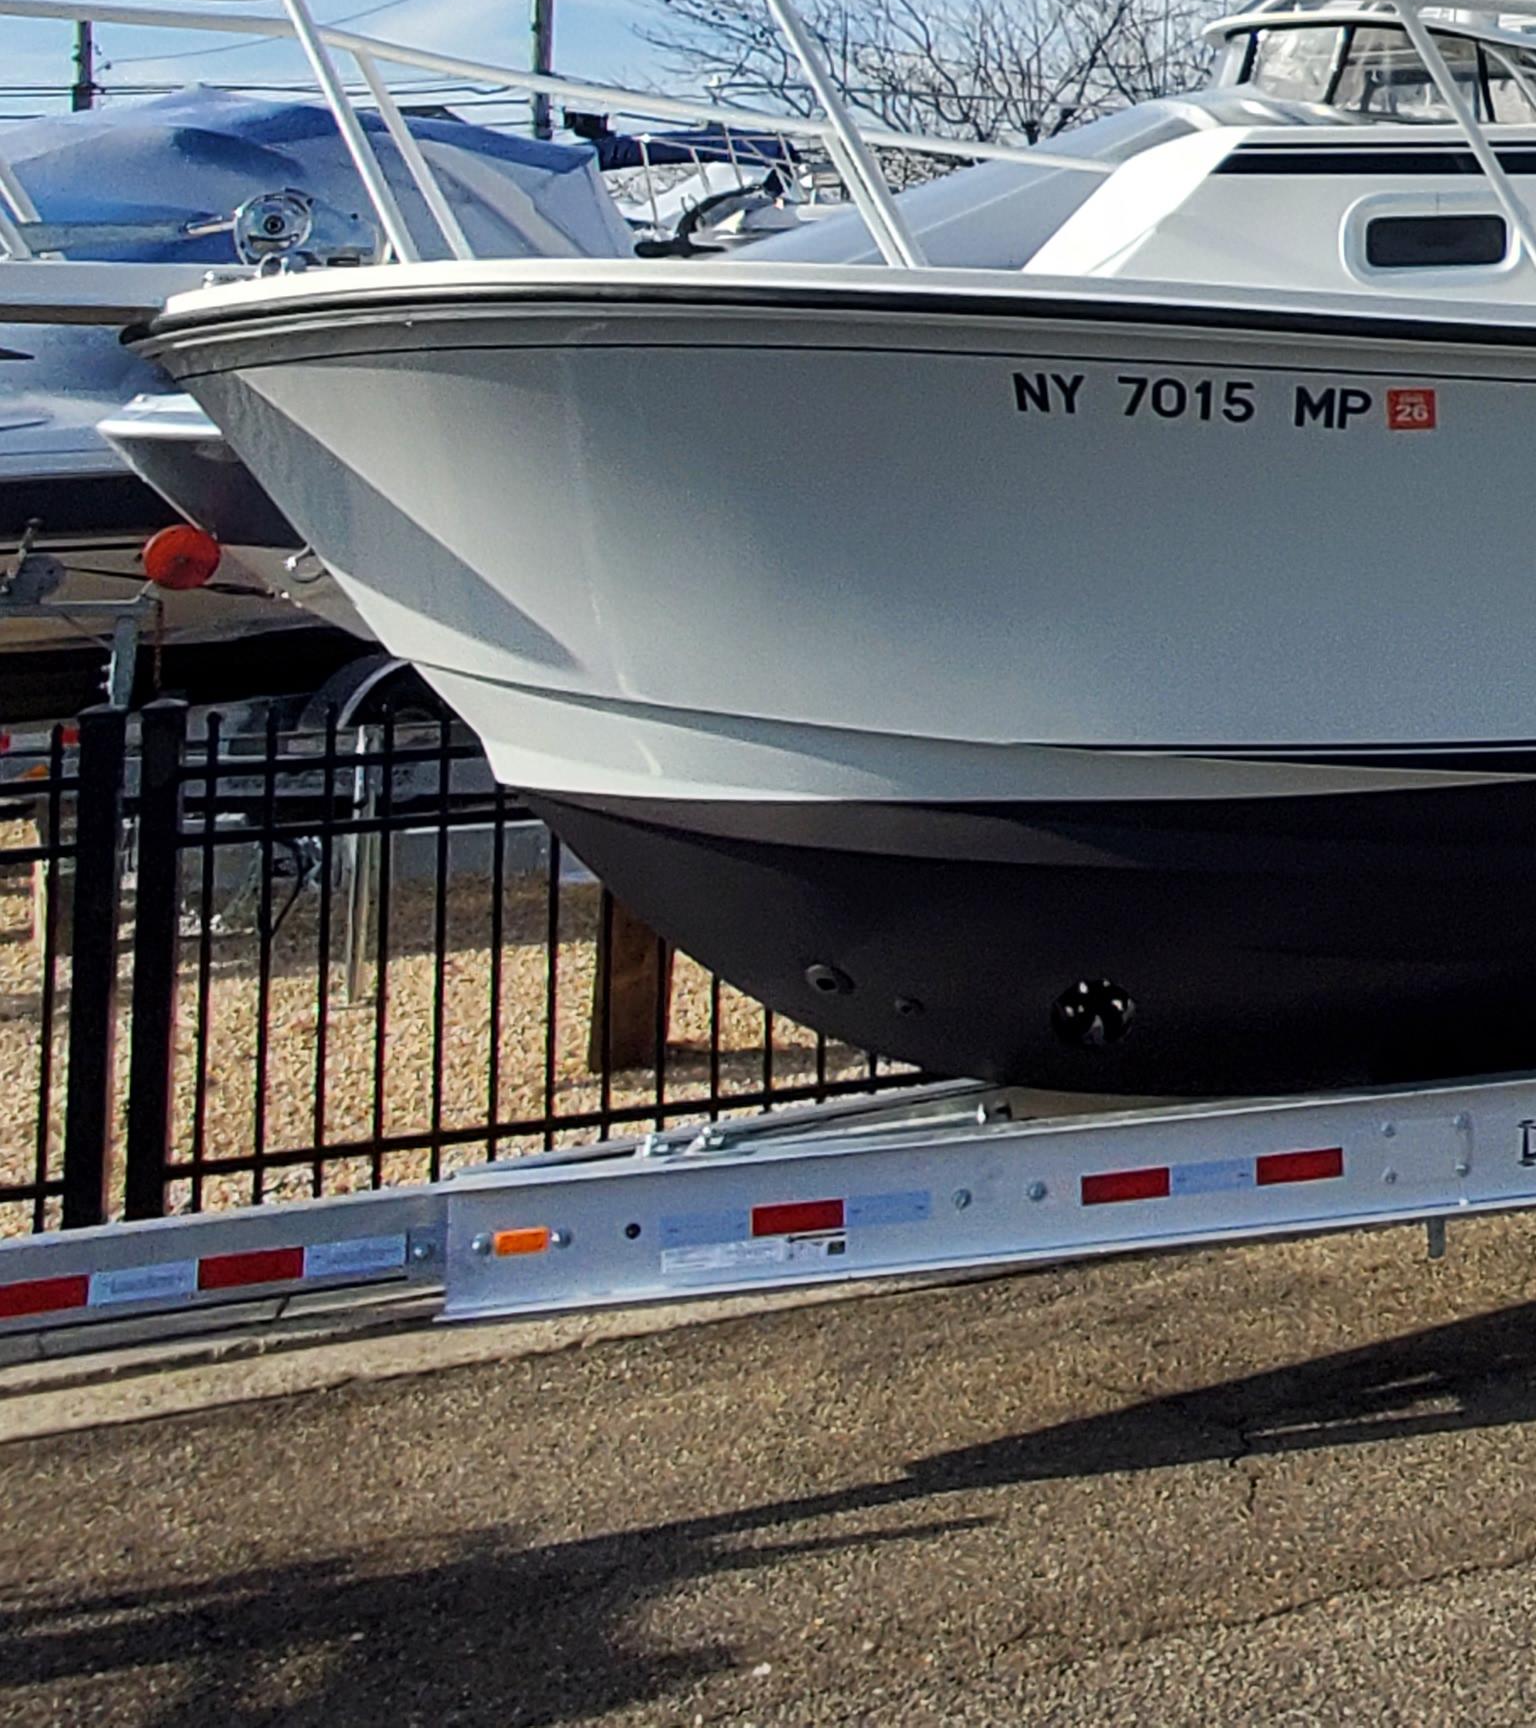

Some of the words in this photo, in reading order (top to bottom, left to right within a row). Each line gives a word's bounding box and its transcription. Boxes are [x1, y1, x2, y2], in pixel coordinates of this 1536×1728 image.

[1012, 372, 1085, 414] NY
[1117, 376, 1255, 423] 7015
[1294, 385, 1372, 429] MP
